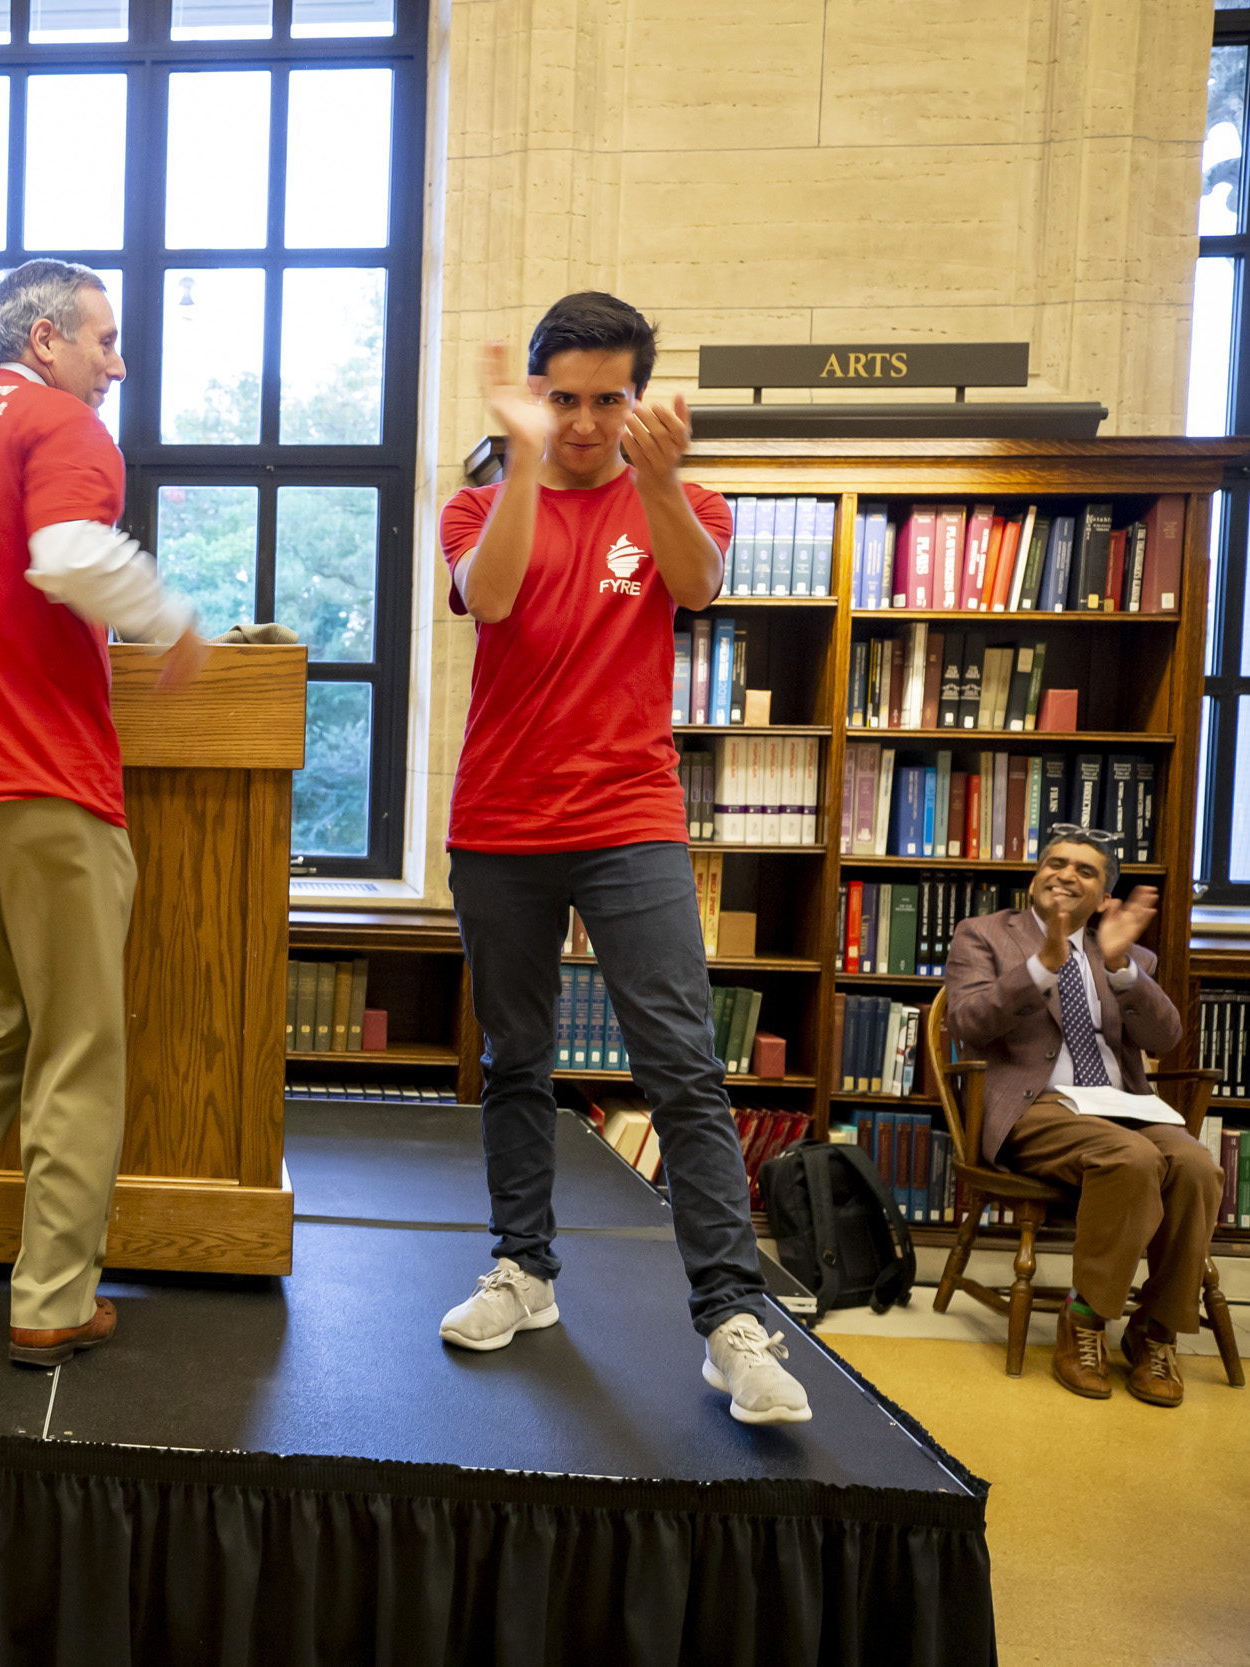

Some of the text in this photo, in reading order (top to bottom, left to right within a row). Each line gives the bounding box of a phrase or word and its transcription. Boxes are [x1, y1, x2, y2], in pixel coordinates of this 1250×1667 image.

[819, 352, 908, 378] ARTS
[916, 536, 930, 575] PLAYS
[599, 578, 642, 596] FYRE
[717, 681, 728, 706] 2018
[1049, 786, 1059, 813] FILMS
